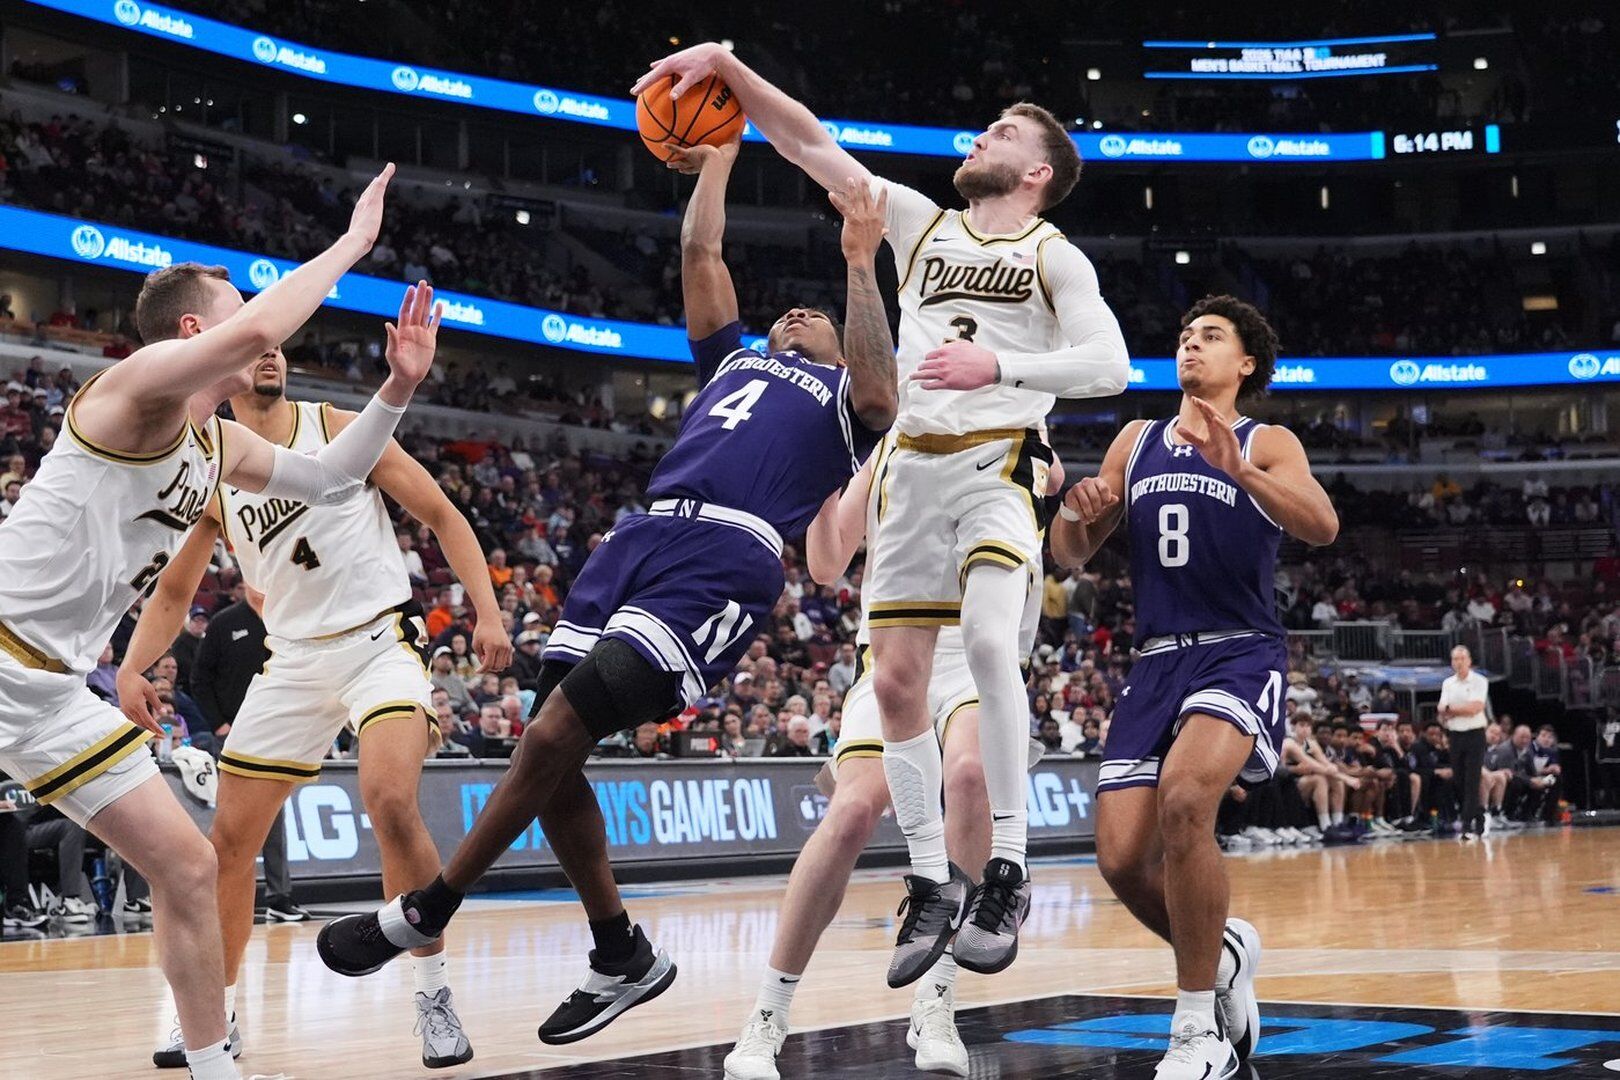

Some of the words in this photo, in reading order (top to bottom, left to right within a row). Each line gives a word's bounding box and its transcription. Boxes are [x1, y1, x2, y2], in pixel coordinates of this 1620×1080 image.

[140, 10, 194, 38] Allstate
[276, 48, 326, 73] Allstate
[1304, 53, 1387, 71] TOURNAMENT
[417, 75, 473, 98] Allstate
[558, 99, 609, 120] Allstate
[838, 127, 893, 147] Allstate
[1125, 139, 1183, 155] Allstate
[1272, 140, 1330, 156] Allstate
[1393, 133, 1439, 153] 6:14
[1441, 130, 1473, 151] PM
[104, 237, 172, 267] Allstate
[919, 257, 1035, 303] Purdue
[565, 324, 623, 348] Allstate
[717, 356, 834, 407] THWESTERN
[1272, 366, 1315, 383] state
[1420, 364, 1487, 382] Allstate
[708, 379, 769, 430] 4
[1131, 472, 1237, 507] NORTHWESTERN
[1158, 503, 1190, 568] 8
[289, 536, 321, 571] 4
[650, 780, 736, 844] GAME
[733, 778, 777, 840] ON
[1028, 771, 1090, 827] 1G+
